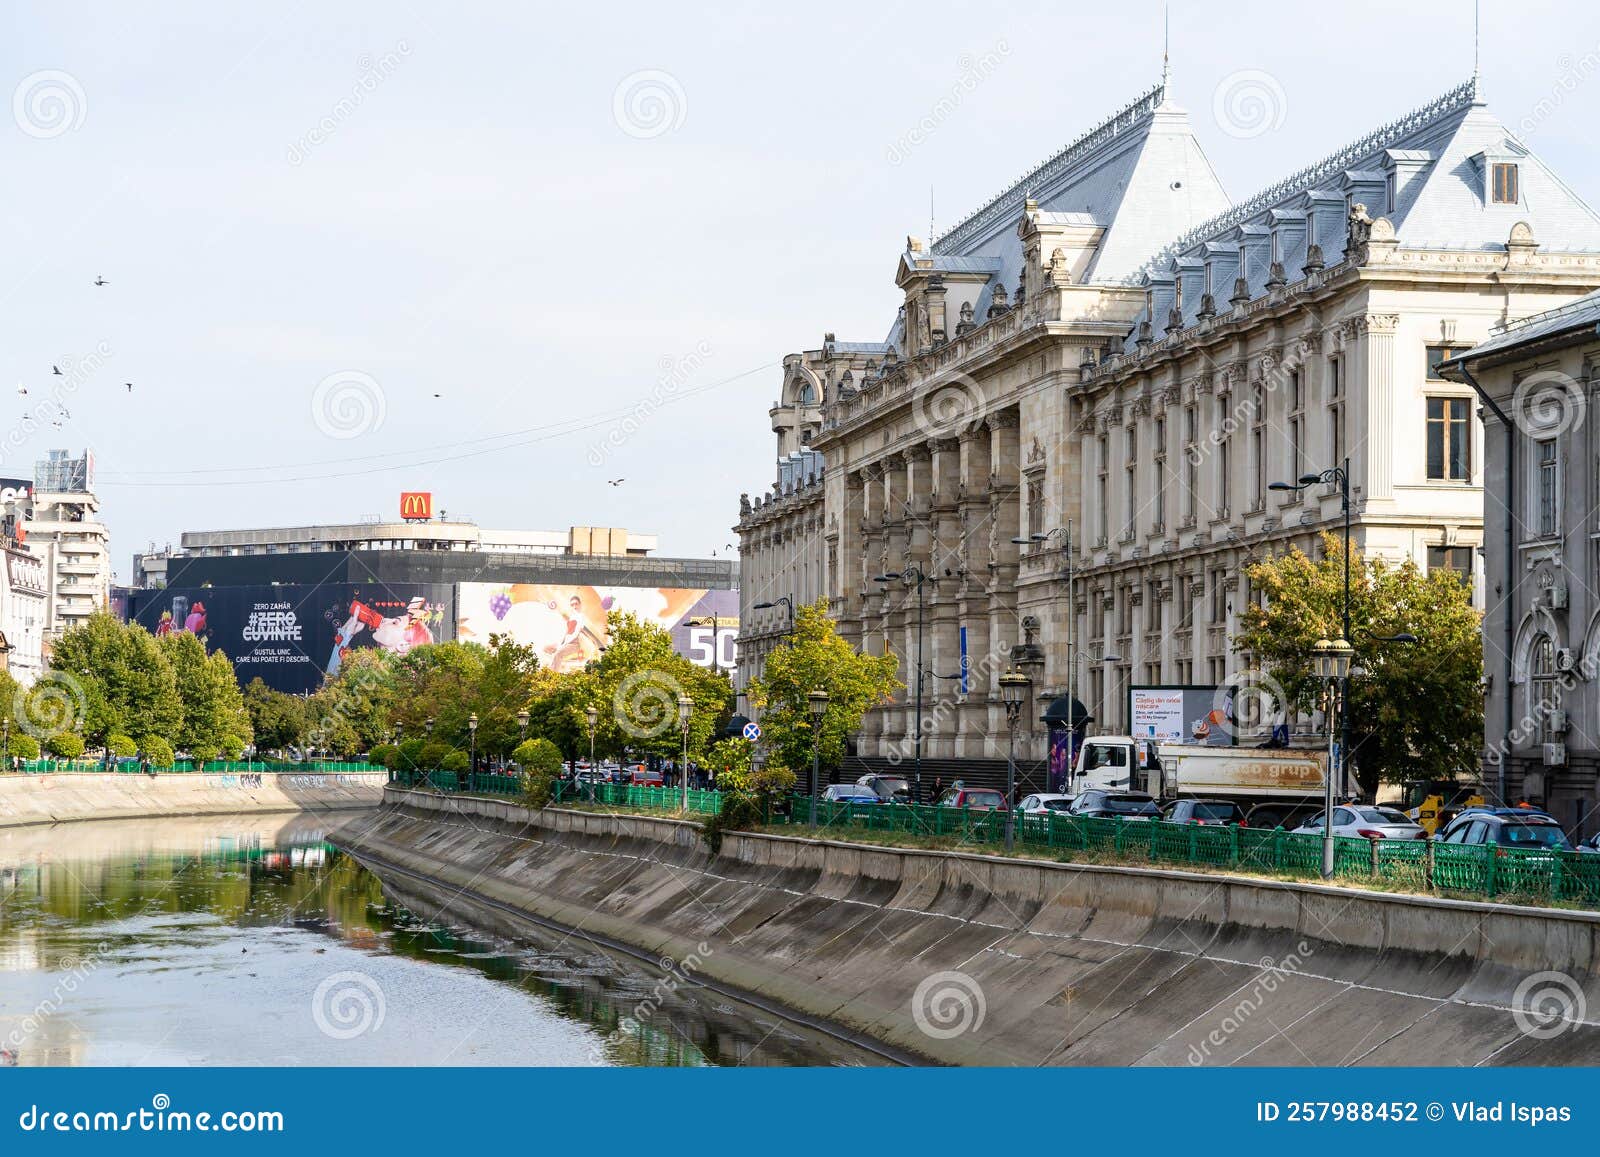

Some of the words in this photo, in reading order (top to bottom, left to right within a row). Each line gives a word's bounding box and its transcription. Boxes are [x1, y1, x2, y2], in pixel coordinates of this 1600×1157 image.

[249, 611, 297, 627] #ZERO
[243, 626, 302, 641] CUVINTE
[254, 648, 276, 656] GUSTUL
[277, 648, 291, 656] UNIC
[286, 655, 310, 663] DESCRIS
[1269, 764, 1310, 778] grup
